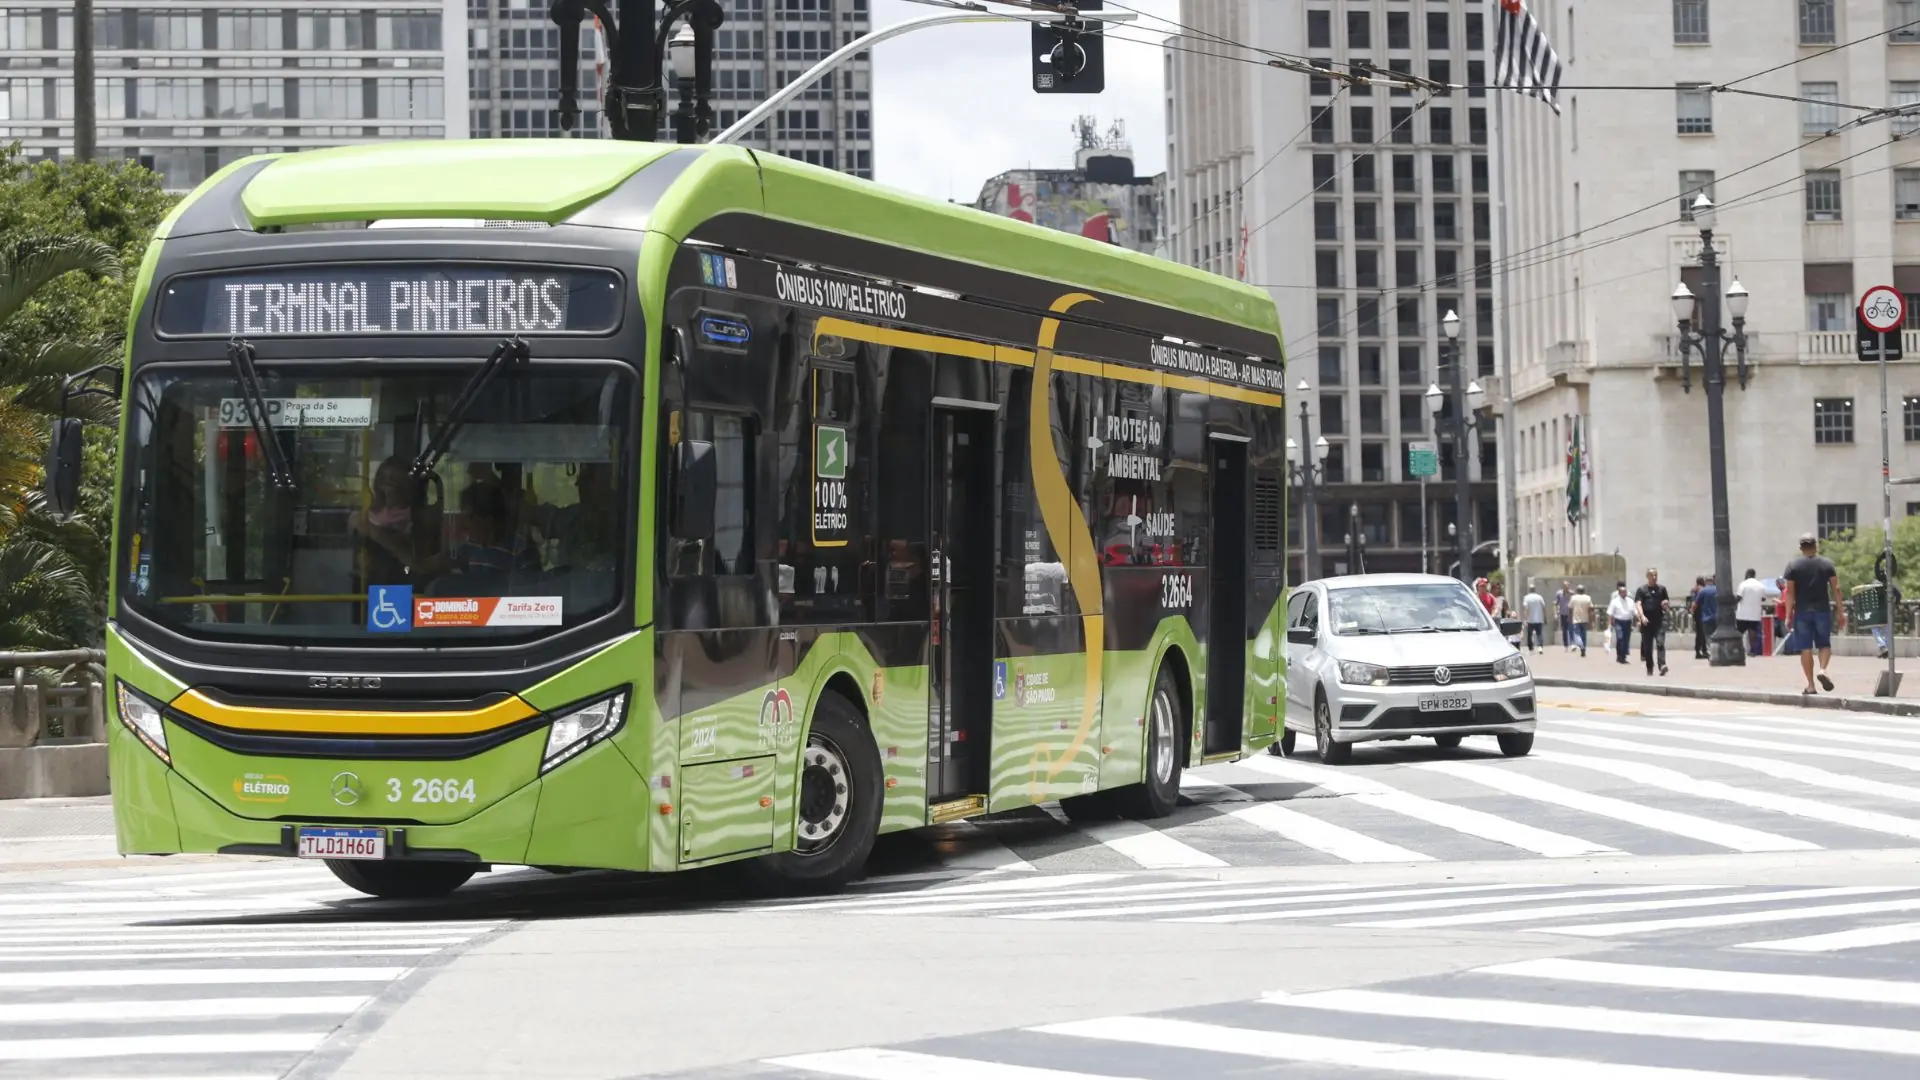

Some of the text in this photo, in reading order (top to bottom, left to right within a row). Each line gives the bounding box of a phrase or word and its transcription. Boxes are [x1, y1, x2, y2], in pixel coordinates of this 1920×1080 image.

[776, 264, 823, 307] ÔNIBUS
[823, 279, 852, 312] 100%
[850, 280, 906, 319] ELÉTRICO
[225, 278, 562, 334] TERMINAL PINHEIROS
[1151, 339, 1177, 368] ÔNIBUS
[1178, 350, 1204, 373] MOVIDO
[1205, 361, 1211, 374] A
[1211, 357, 1238, 380] BATERIA
[1241, 364, 1251, 383] AR
[1251, 366, 1266, 386] MAIS
[1266, 369, 1283, 389] PURO
[286, 401, 338, 412] Praça da Sé
[284, 416, 298, 425] Pça
[337, 416, 369, 424] Azevedo
[1107, 415, 1160, 450] PROTEÇÃO
[1107, 453, 1161, 481] AMBIENTAL
[815, 481, 847, 508] 100%
[815, 509, 847, 529] ELÉTRICO
[1146, 507, 1175, 536] SAÚDE
[434, 599, 478, 613] DOMINGÃO
[508, 603, 555, 612] Tarifa Zero
[694, 727, 716, 747] 2024
[243, 780, 290, 794] ELÉTRICO
[385, 777, 476, 804] 3 2664
[306, 837, 374, 855] TLD1H60
